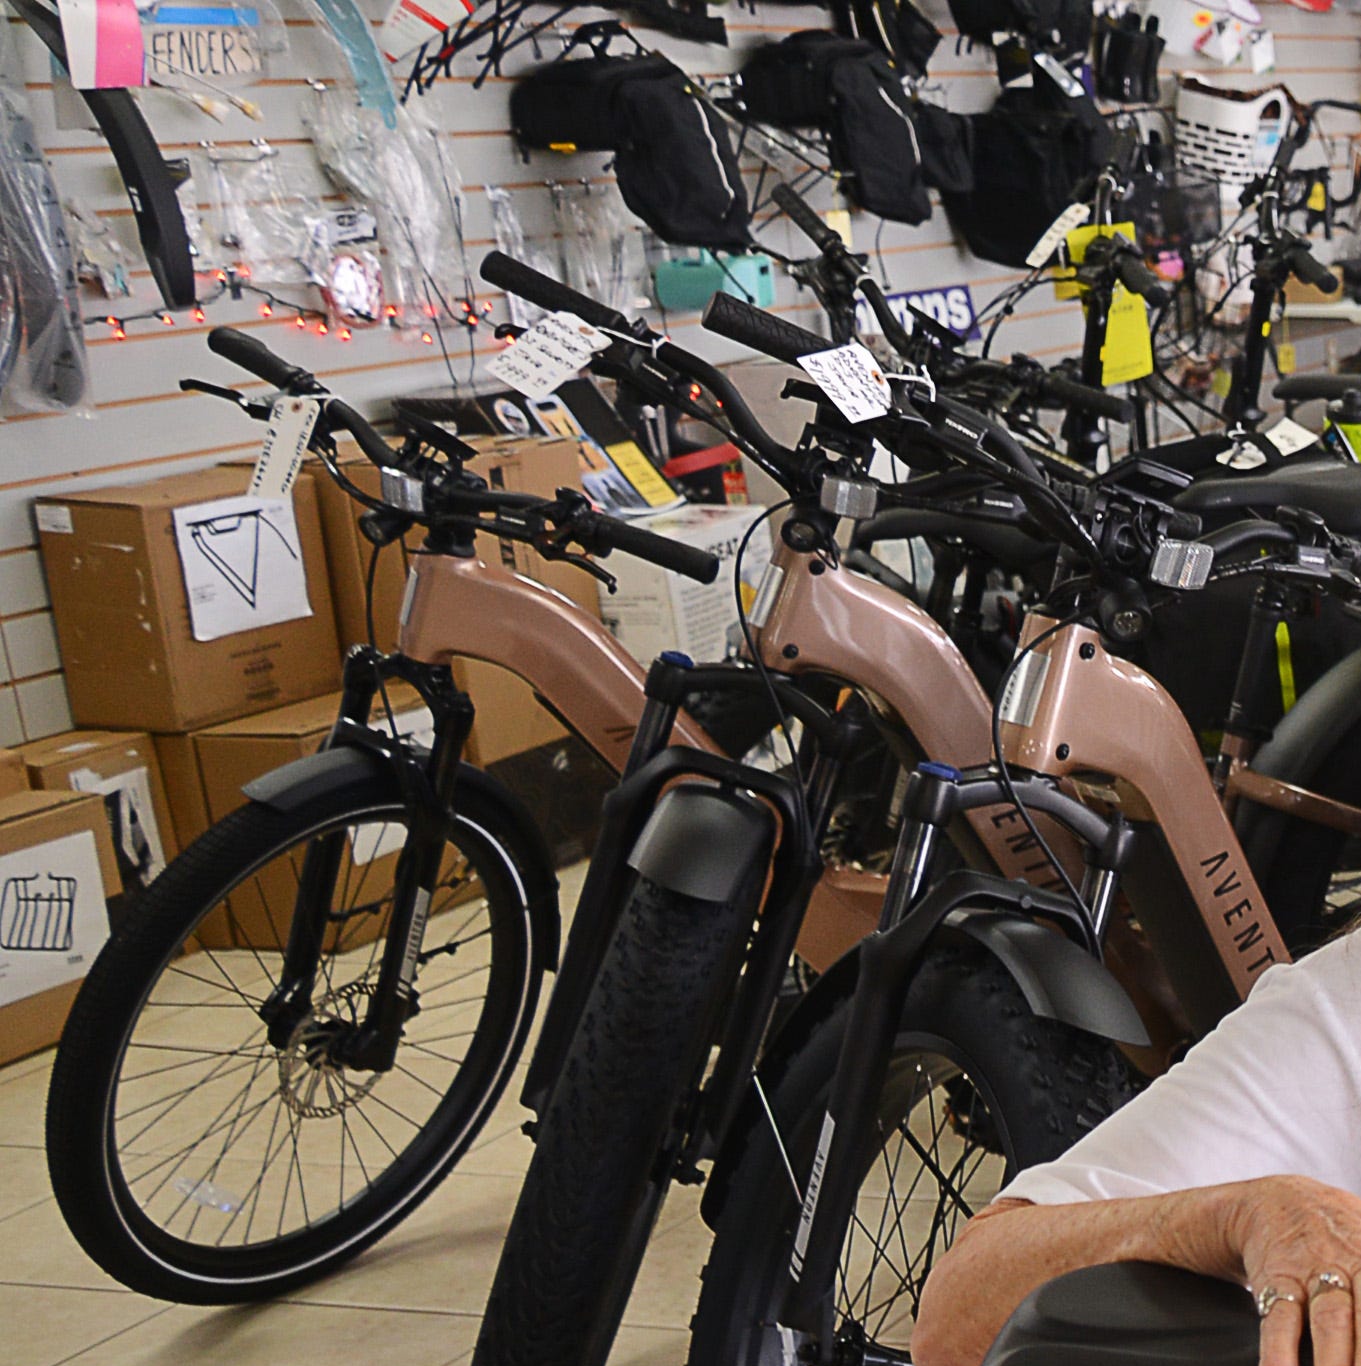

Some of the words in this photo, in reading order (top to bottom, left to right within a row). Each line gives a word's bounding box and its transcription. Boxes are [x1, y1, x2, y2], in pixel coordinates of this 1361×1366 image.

[153, 30, 256, 74] FENDERS
[1201, 851, 1275, 972] AVENT
[802, 1152, 825, 1225] AVENTON
